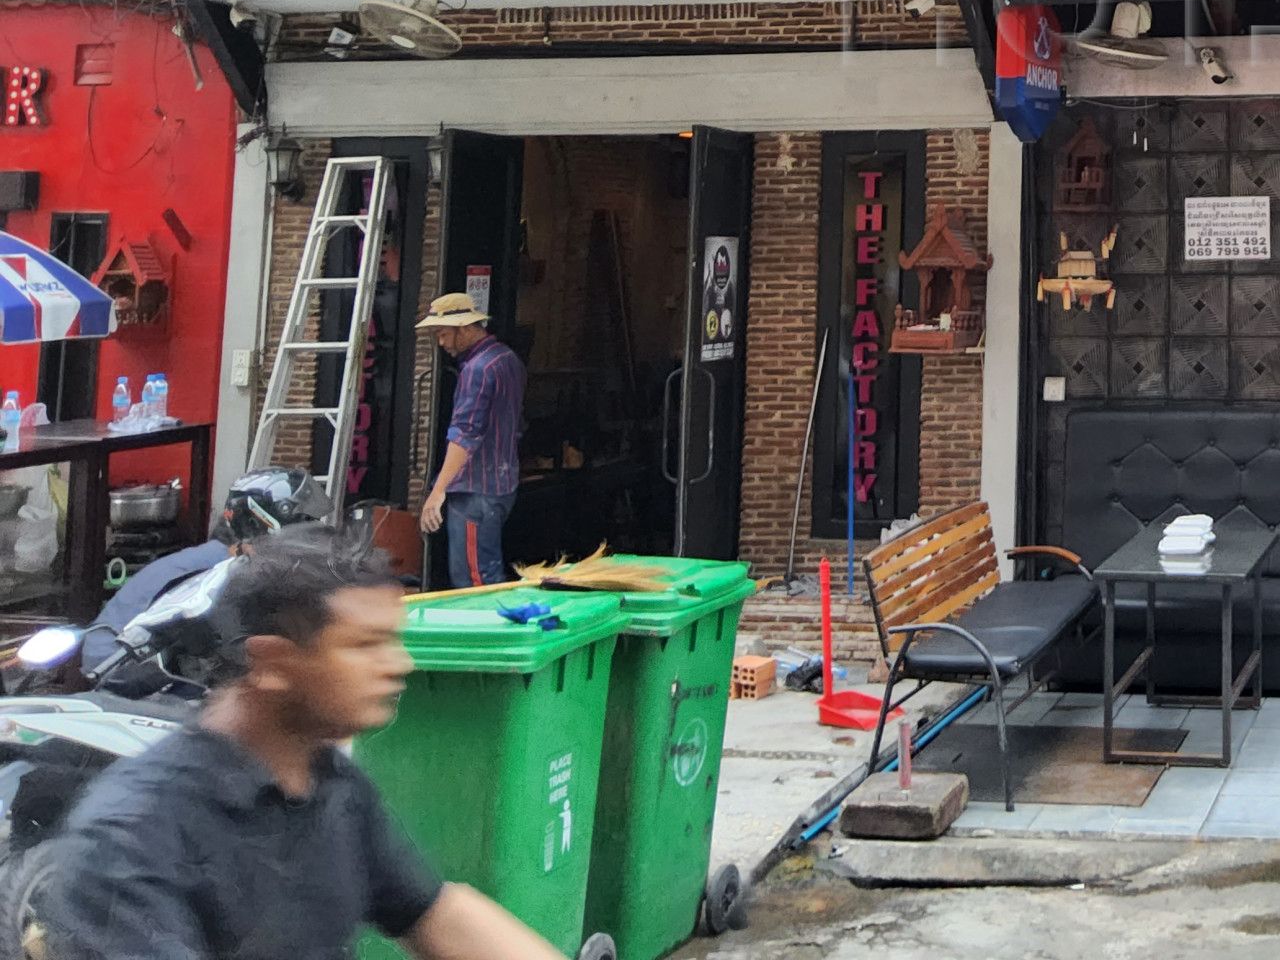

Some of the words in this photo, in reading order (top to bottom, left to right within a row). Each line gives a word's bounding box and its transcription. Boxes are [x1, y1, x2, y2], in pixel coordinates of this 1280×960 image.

[1026, 62, 1058, 91] ANCHOR
[854, 171, 883, 266] THE
[1188, 238, 1212, 247] 012
[1215, 237, 1239, 246] 351
[1242, 236, 1267, 246] 492
[1188, 248, 1212, 257] 069
[1216, 247, 1240, 256] 799
[1243, 246, 1268, 256] 954
[851, 277, 881, 503] FACTORY
